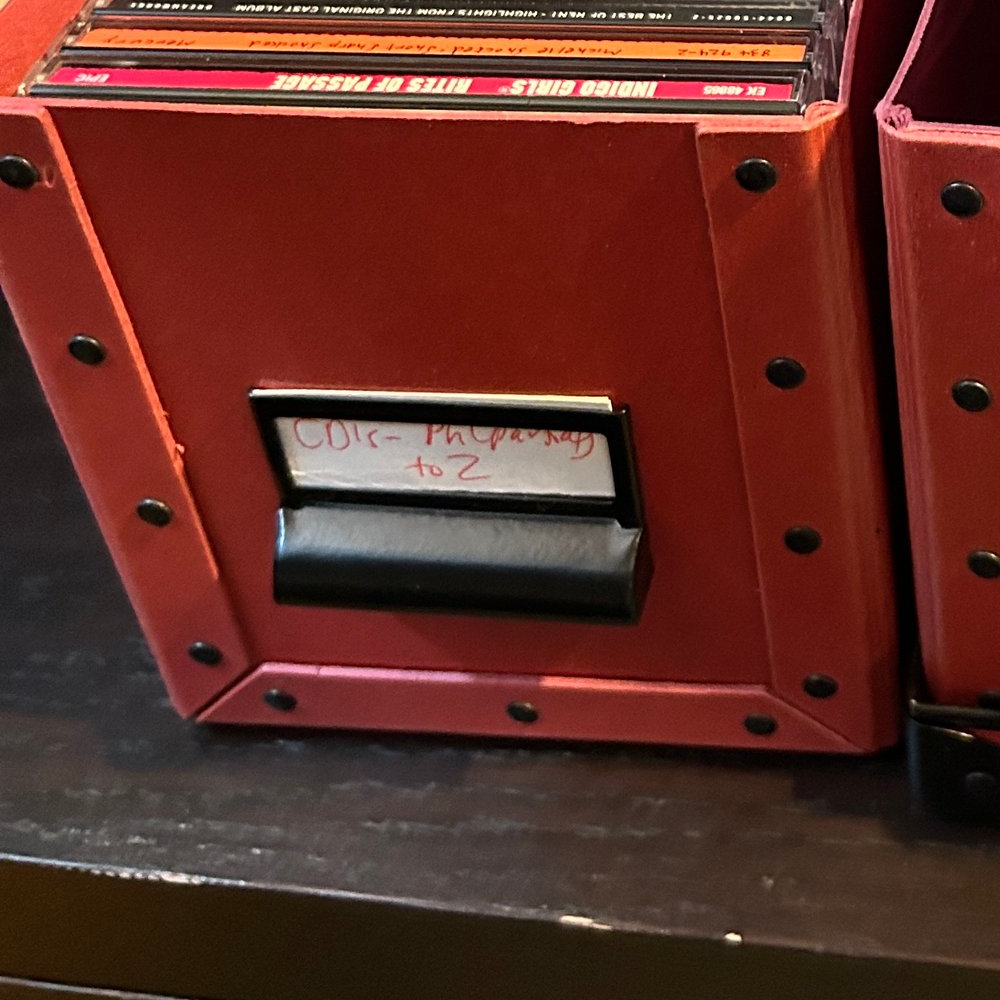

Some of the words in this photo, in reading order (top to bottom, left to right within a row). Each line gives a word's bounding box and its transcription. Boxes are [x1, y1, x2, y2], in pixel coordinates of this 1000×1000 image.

[235, 3, 283, 13] ALBUM
[284, 4, 319, 14] CAST
[322, 5, 385, 15] ORIGINAL
[389, 7, 413, 15] THE
[416, 7, 455, 17] FROM
[457, 7, 537, 18] HIGHLIGHTS
[611, 11, 645, 21] BEST
[648, 12, 673, 21] THE
[75, 72, 111, 84] EPIC
[268, 73, 373, 92] PASSAGE
[374, 76, 405, 93] OF
[407, 76, 473, 95] RITES
[509, 78, 577, 97] GIRLS
[578, 80, 660, 98] INDIGO
[745, 86, 767, 96] EK
[405, 455, 444, 478] to
